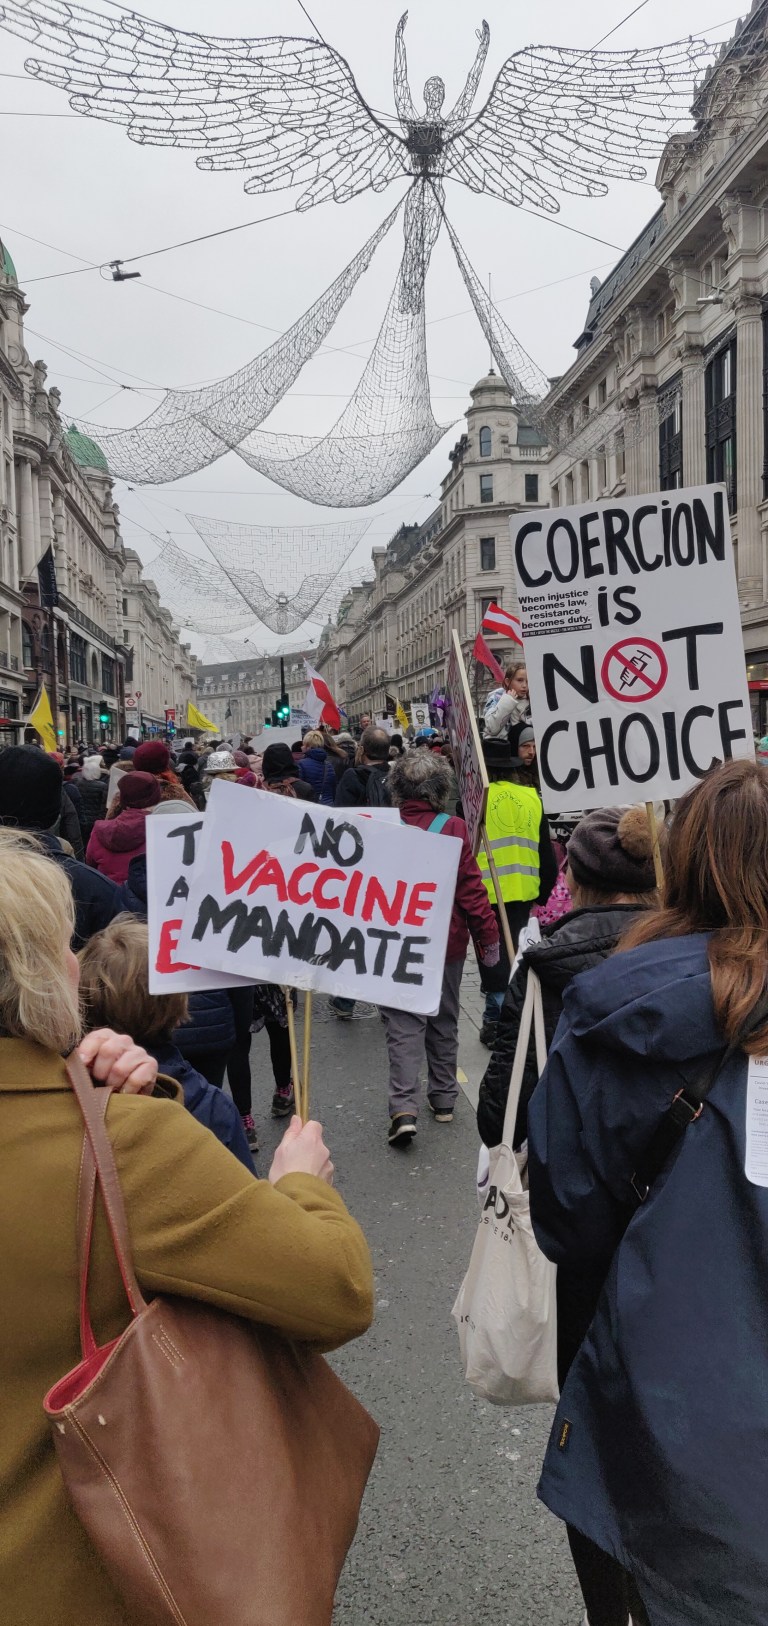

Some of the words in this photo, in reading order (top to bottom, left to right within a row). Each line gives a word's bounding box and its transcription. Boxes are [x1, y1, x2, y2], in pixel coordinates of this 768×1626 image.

[518, 596, 545, 604] When
[548, 590, 589, 601] injustice
[521, 601, 565, 612] becomes
[568, 599, 587, 607] law,
[530, 608, 580, 620] resistance
[521, 619, 565, 629] becomes
[568, 616, 590, 624] duty.
[294, 812, 364, 867] NO
[221, 840, 438, 926] VACCINE
[191, 894, 431, 985] MANDATE
